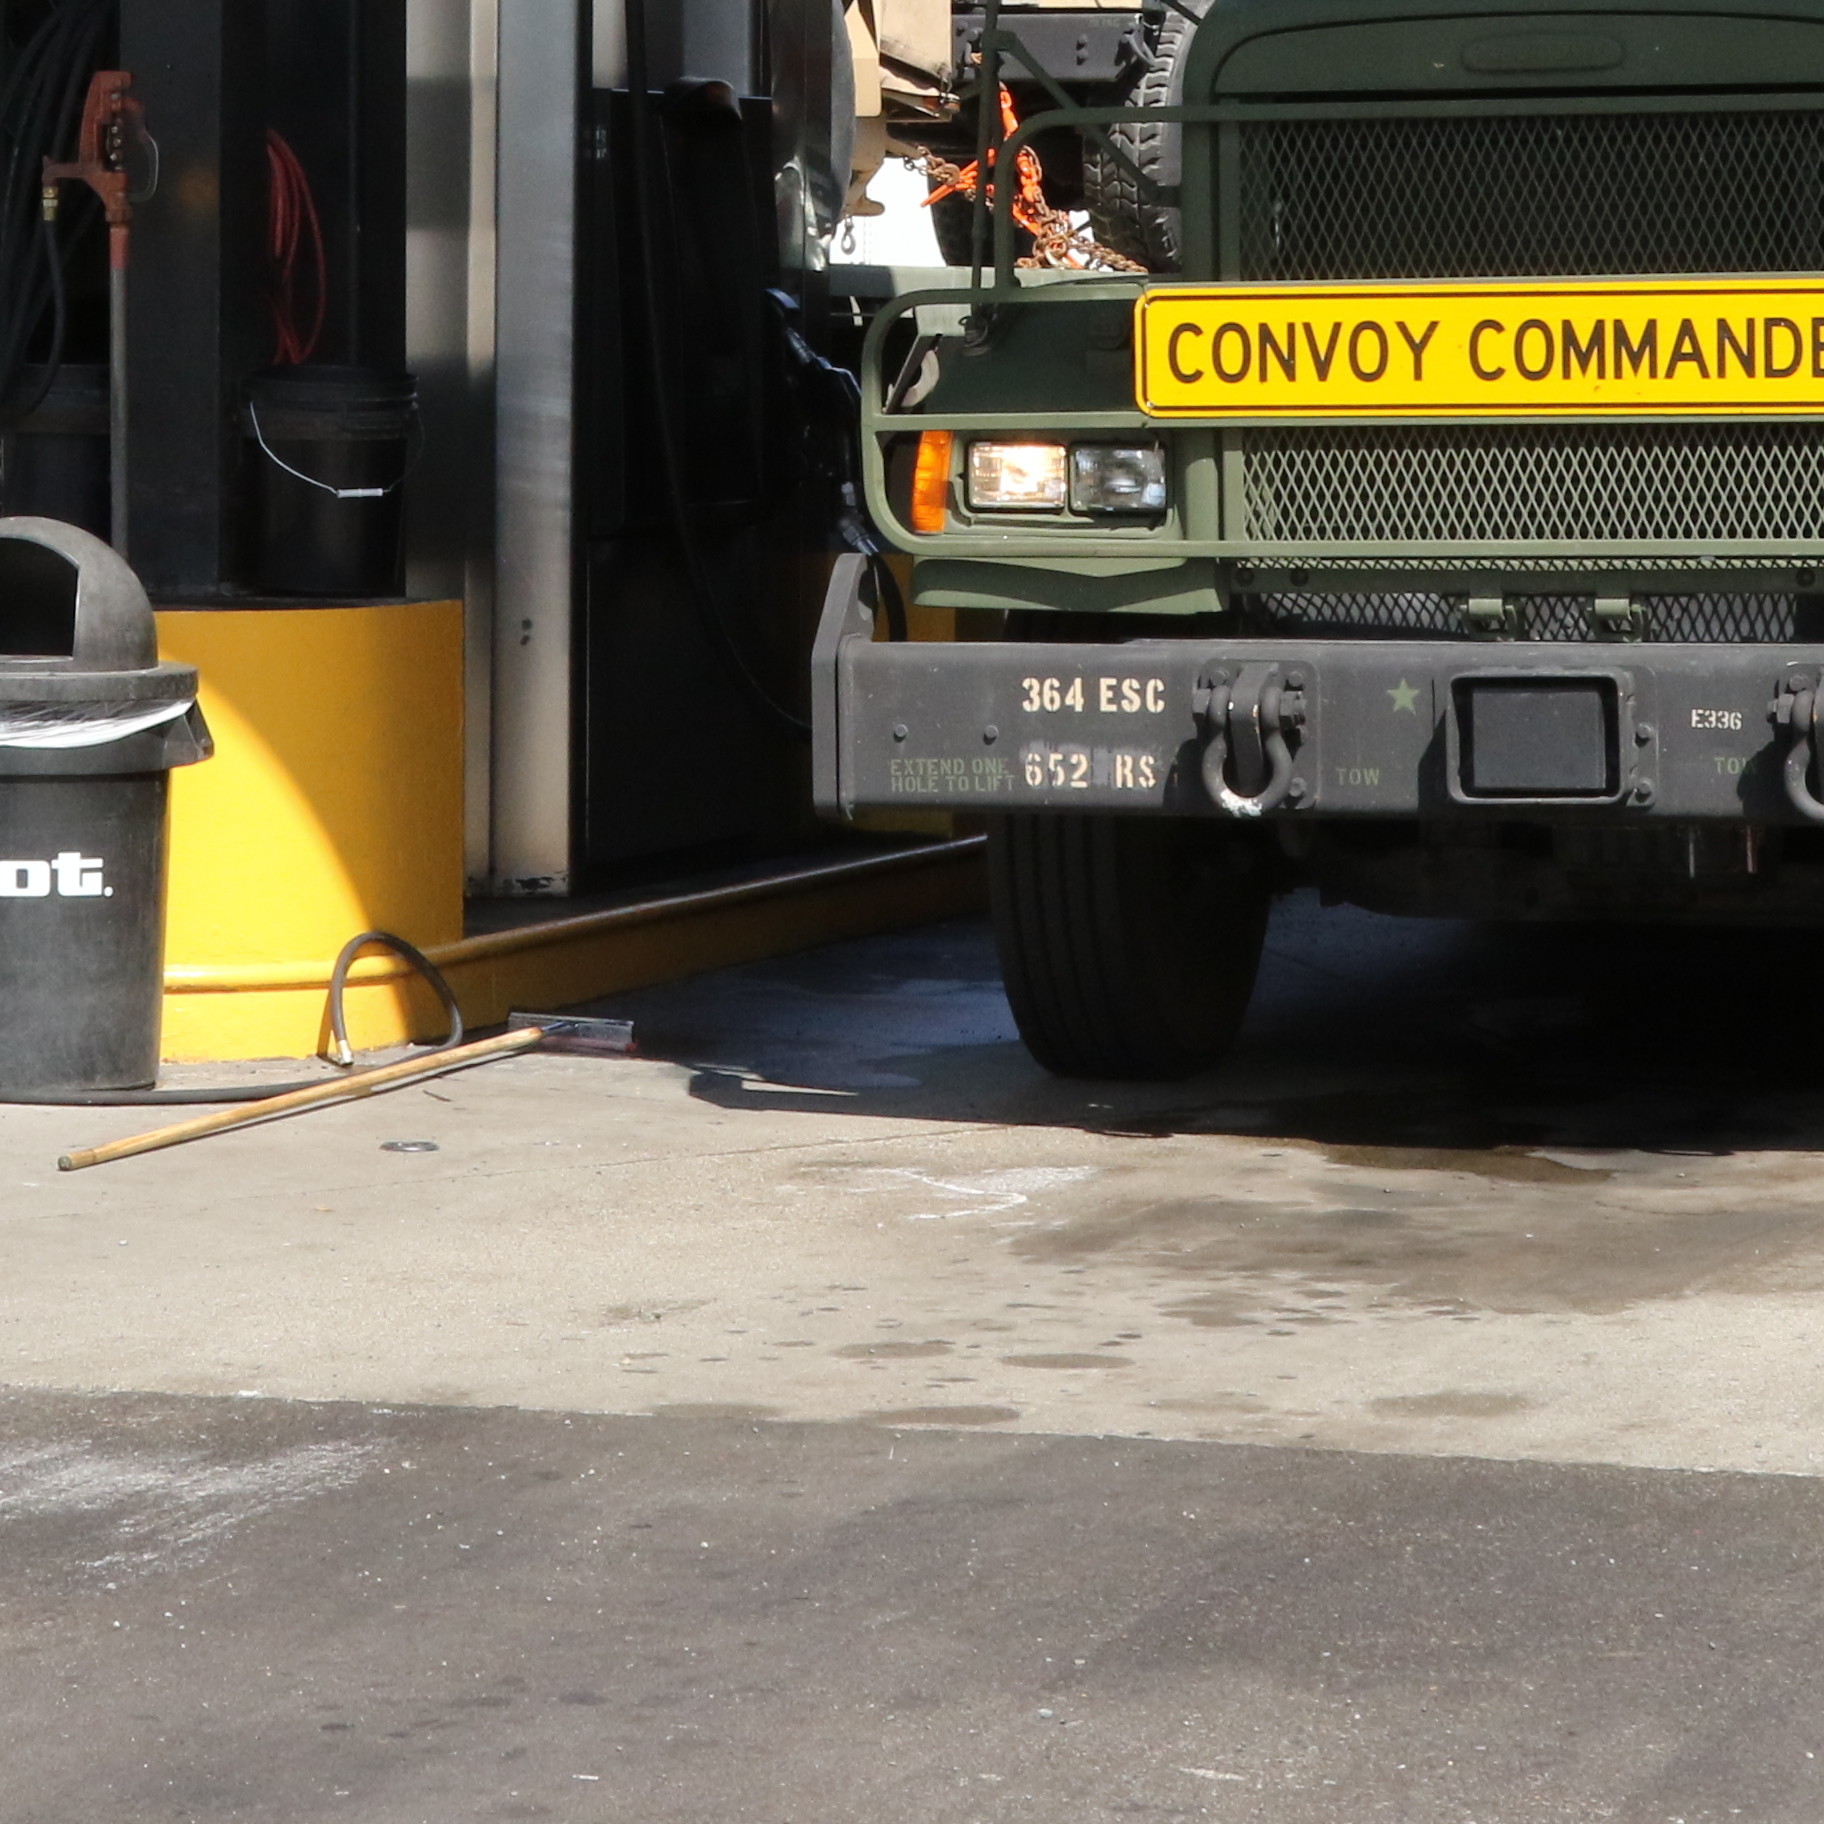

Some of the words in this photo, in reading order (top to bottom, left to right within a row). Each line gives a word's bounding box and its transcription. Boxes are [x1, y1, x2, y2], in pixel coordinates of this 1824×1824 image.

[1166, 321, 1441, 385] CONVOY
[1022, 677, 1084, 713] 364
[1099, 677, 1165, 714] ESC
[1691, 708, 1743, 731] E336
[891, 757, 965, 776] EXTEND
[972, 758, 1008, 776] ONE
[1026, 752, 1088, 789] 652
[1714, 756, 1749, 775] TO
[891, 775, 939, 793] HOLE
[945, 775, 970, 792] TO
[975, 775, 1015, 792] LIFT
[1336, 767, 1379, 786] TOW
